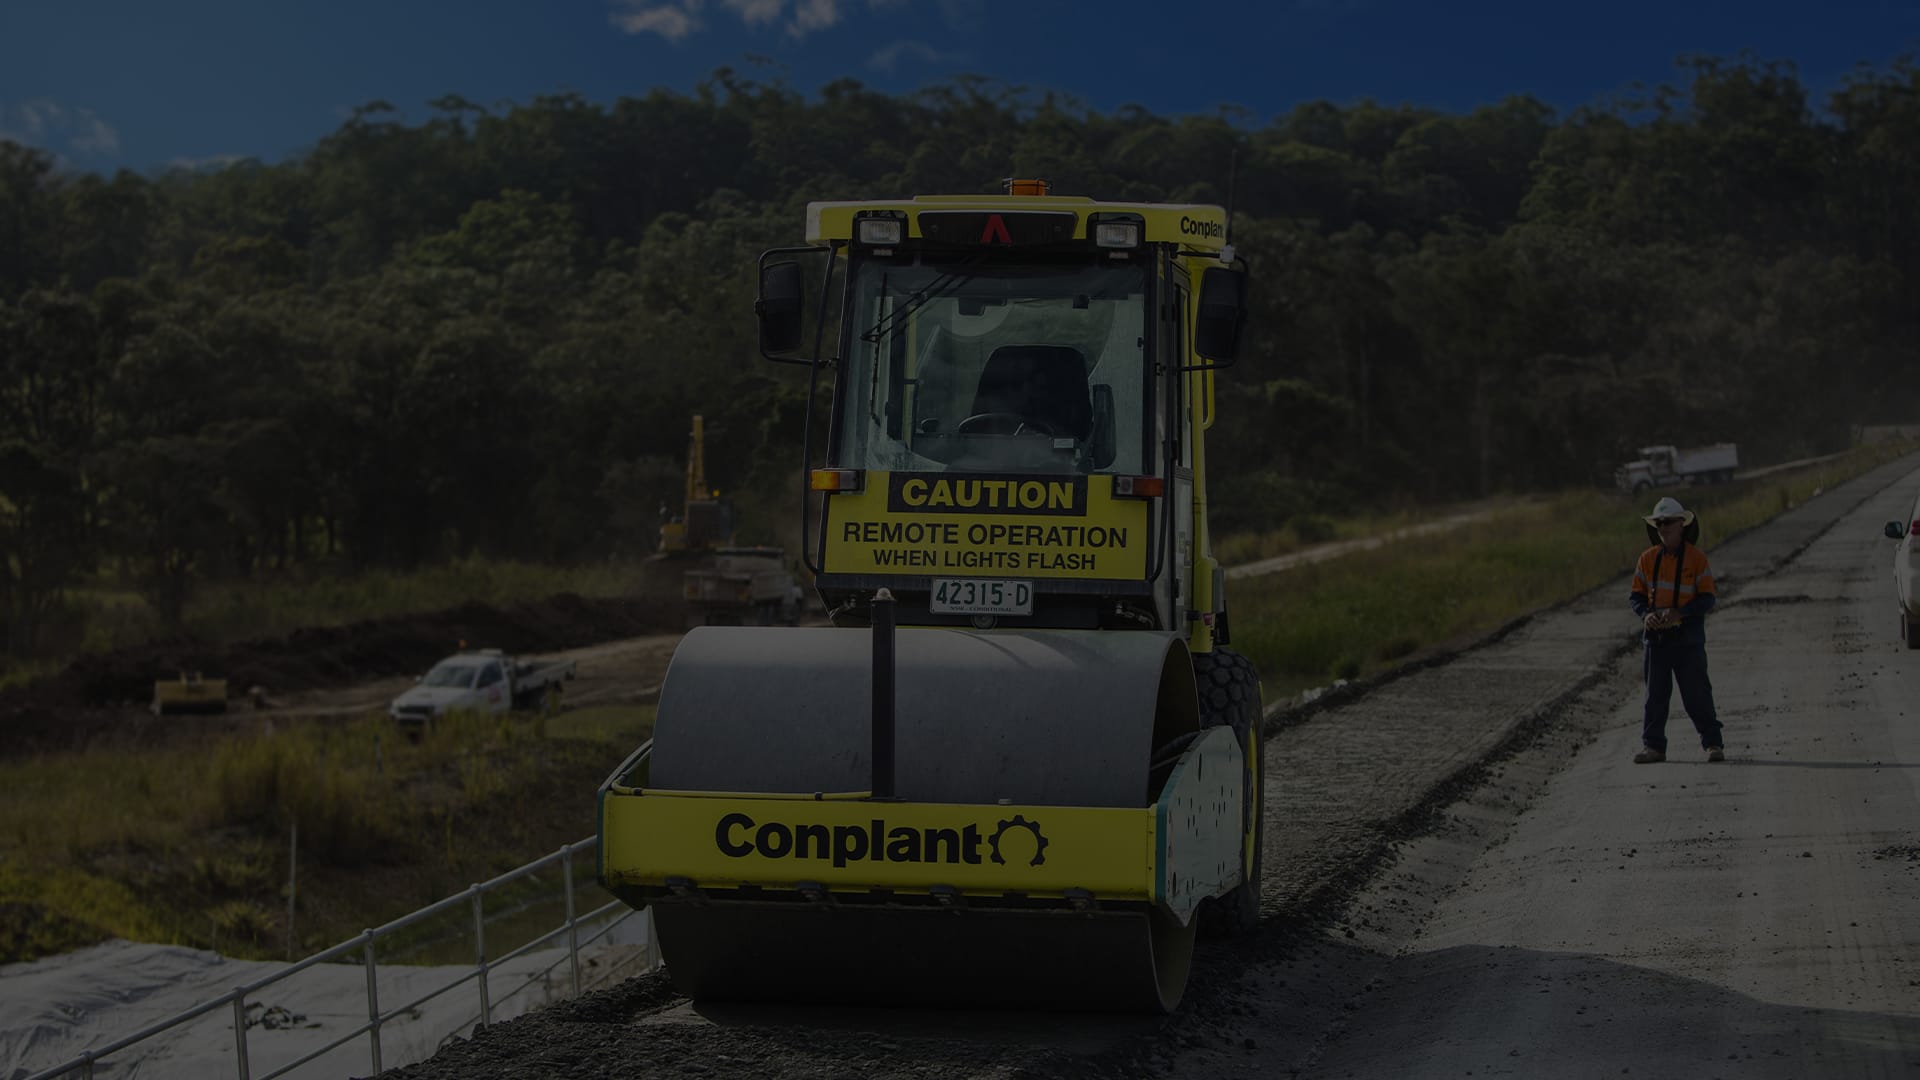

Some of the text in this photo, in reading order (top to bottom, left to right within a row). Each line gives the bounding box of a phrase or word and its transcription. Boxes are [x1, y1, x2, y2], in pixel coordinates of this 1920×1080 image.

[1180, 216, 1224, 239] Conplan
[901, 478, 1074, 510] CAUTION
[843, 522, 1127, 548] REMOTE OPERATION
[873, 549, 1096, 570] WHEN LIGHTS FLASH
[936, 582, 1029, 606] 42315-D
[715, 813, 982, 868] Conplant
